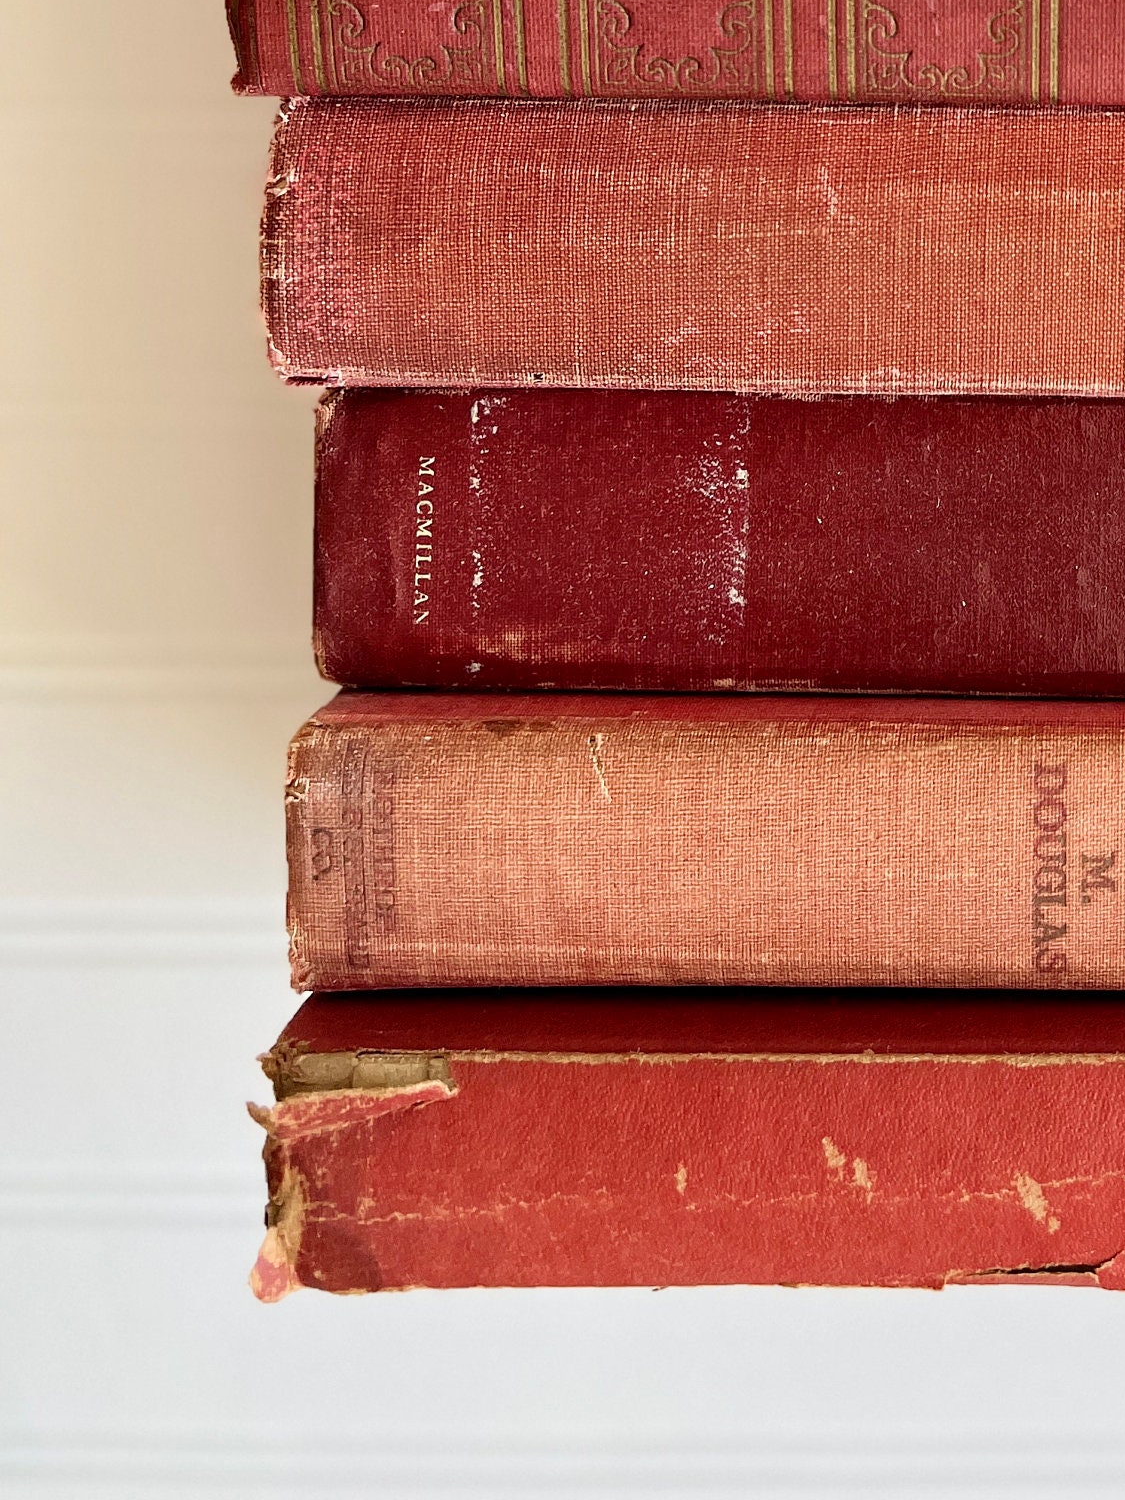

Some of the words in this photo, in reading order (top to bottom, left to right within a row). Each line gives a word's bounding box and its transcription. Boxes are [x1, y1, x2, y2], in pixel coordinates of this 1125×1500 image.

[412, 456, 435, 625] MACMILLAN
[1030, 761, 1067, 973] DOUGLAS
[1080, 853, 1116, 905] M.
